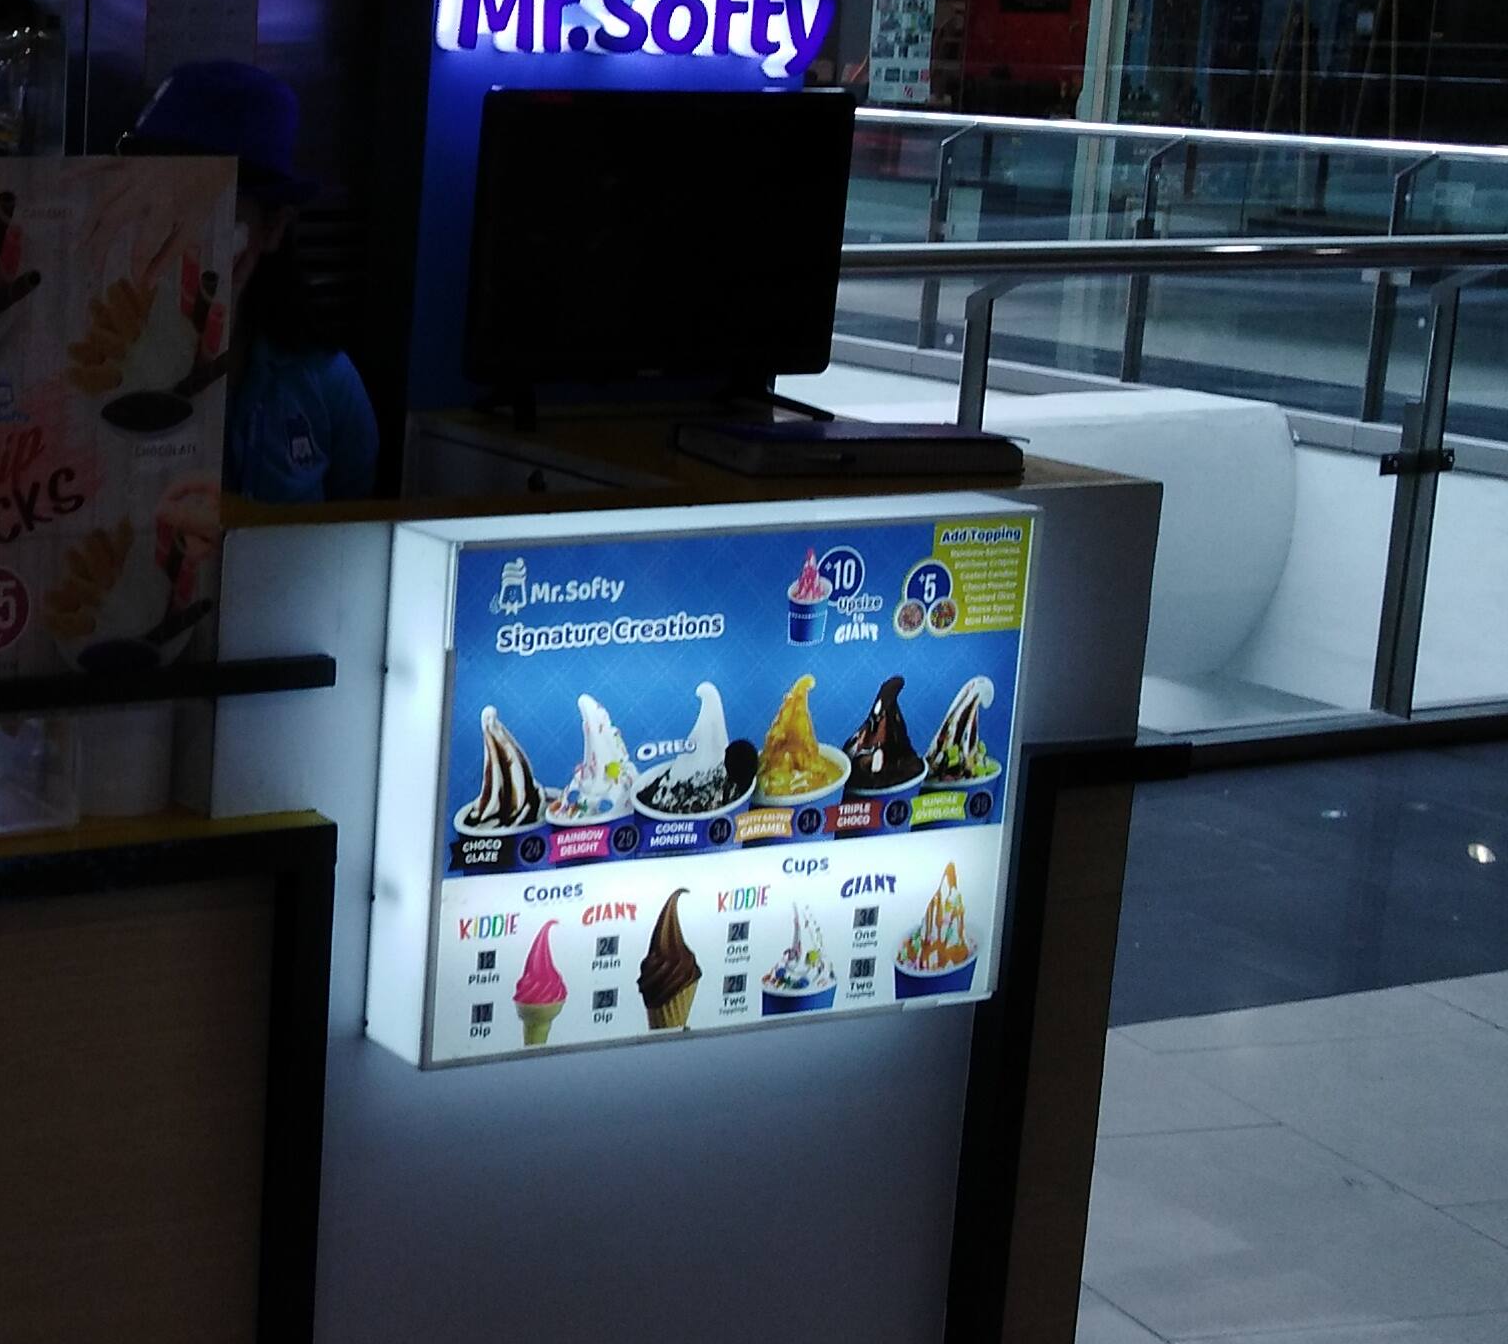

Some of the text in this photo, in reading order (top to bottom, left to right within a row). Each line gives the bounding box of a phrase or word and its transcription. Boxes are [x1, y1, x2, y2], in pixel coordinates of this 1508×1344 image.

[940, 524, 1022, 545] Add Topping
[530, 576, 625, 605] Mr.Softy
[497, 612, 724, 656] Signature Creations
[834, 622, 878, 644] GIANT
[637, 739, 696, 761] OREO
[838, 803, 871, 815] TRIPLE
[836, 814, 871, 827] CHOCO
[655, 822, 694, 834] COOKIE
[740, 823, 787, 837] CARAMEL
[557, 829, 604, 845] RAINBOW
[650, 833, 697, 847] MONSTER
[462, 839, 502, 852] CHOCO
[560, 841, 599, 856] DELIGHT
[465, 851, 498, 864] GLAZE
[782, 856, 829, 876] Cups
[523, 882, 584, 902] Cones
[840, 873, 897, 899] GIANT
[718, 885, 771, 913] KIDDIE
[582, 902, 637, 926] GIANT
[459, 913, 520, 940] KIDDIE
[854, 929, 877, 940] One
[727, 944, 749, 955] One
[592, 957, 621, 971] Plain
[468, 972, 500, 985] Plain
[850, 980, 873, 991] Two
[723, 996, 746, 1007] Two
[593, 1009, 613, 1024] Dip
[469, 1025, 491, 1038] Dip
